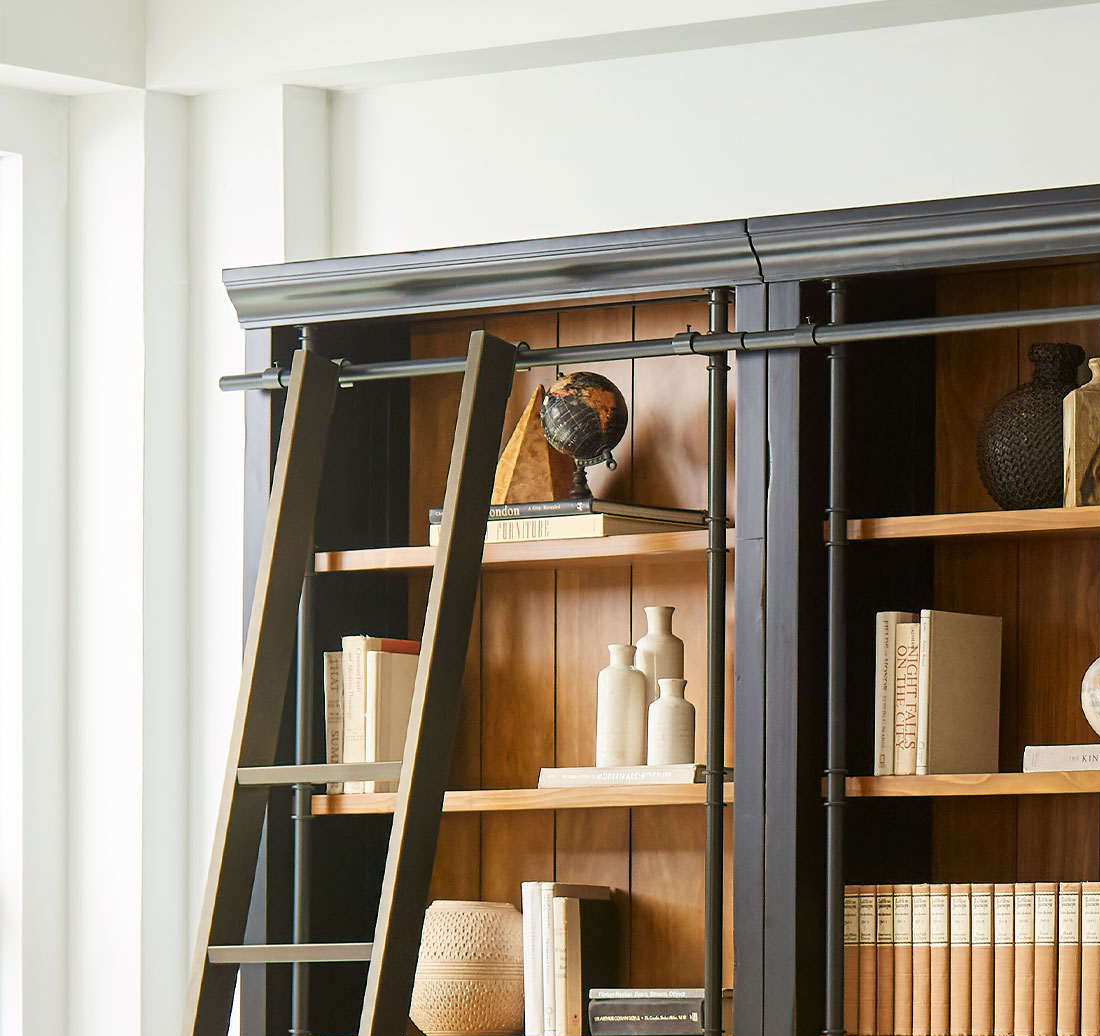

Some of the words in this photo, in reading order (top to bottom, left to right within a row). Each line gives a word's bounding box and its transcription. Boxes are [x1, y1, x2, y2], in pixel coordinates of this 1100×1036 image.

[489, 504, 520, 517] ondon
[496, 519, 550, 541] FURNITURE
[896, 645, 907, 670] ON
[905, 645, 919, 699] NIGHT
[329, 658, 339, 692] THAT
[896, 674, 907, 707] THE
[895, 712, 905, 751] CITY
[904, 704, 917, 750] FALLS
